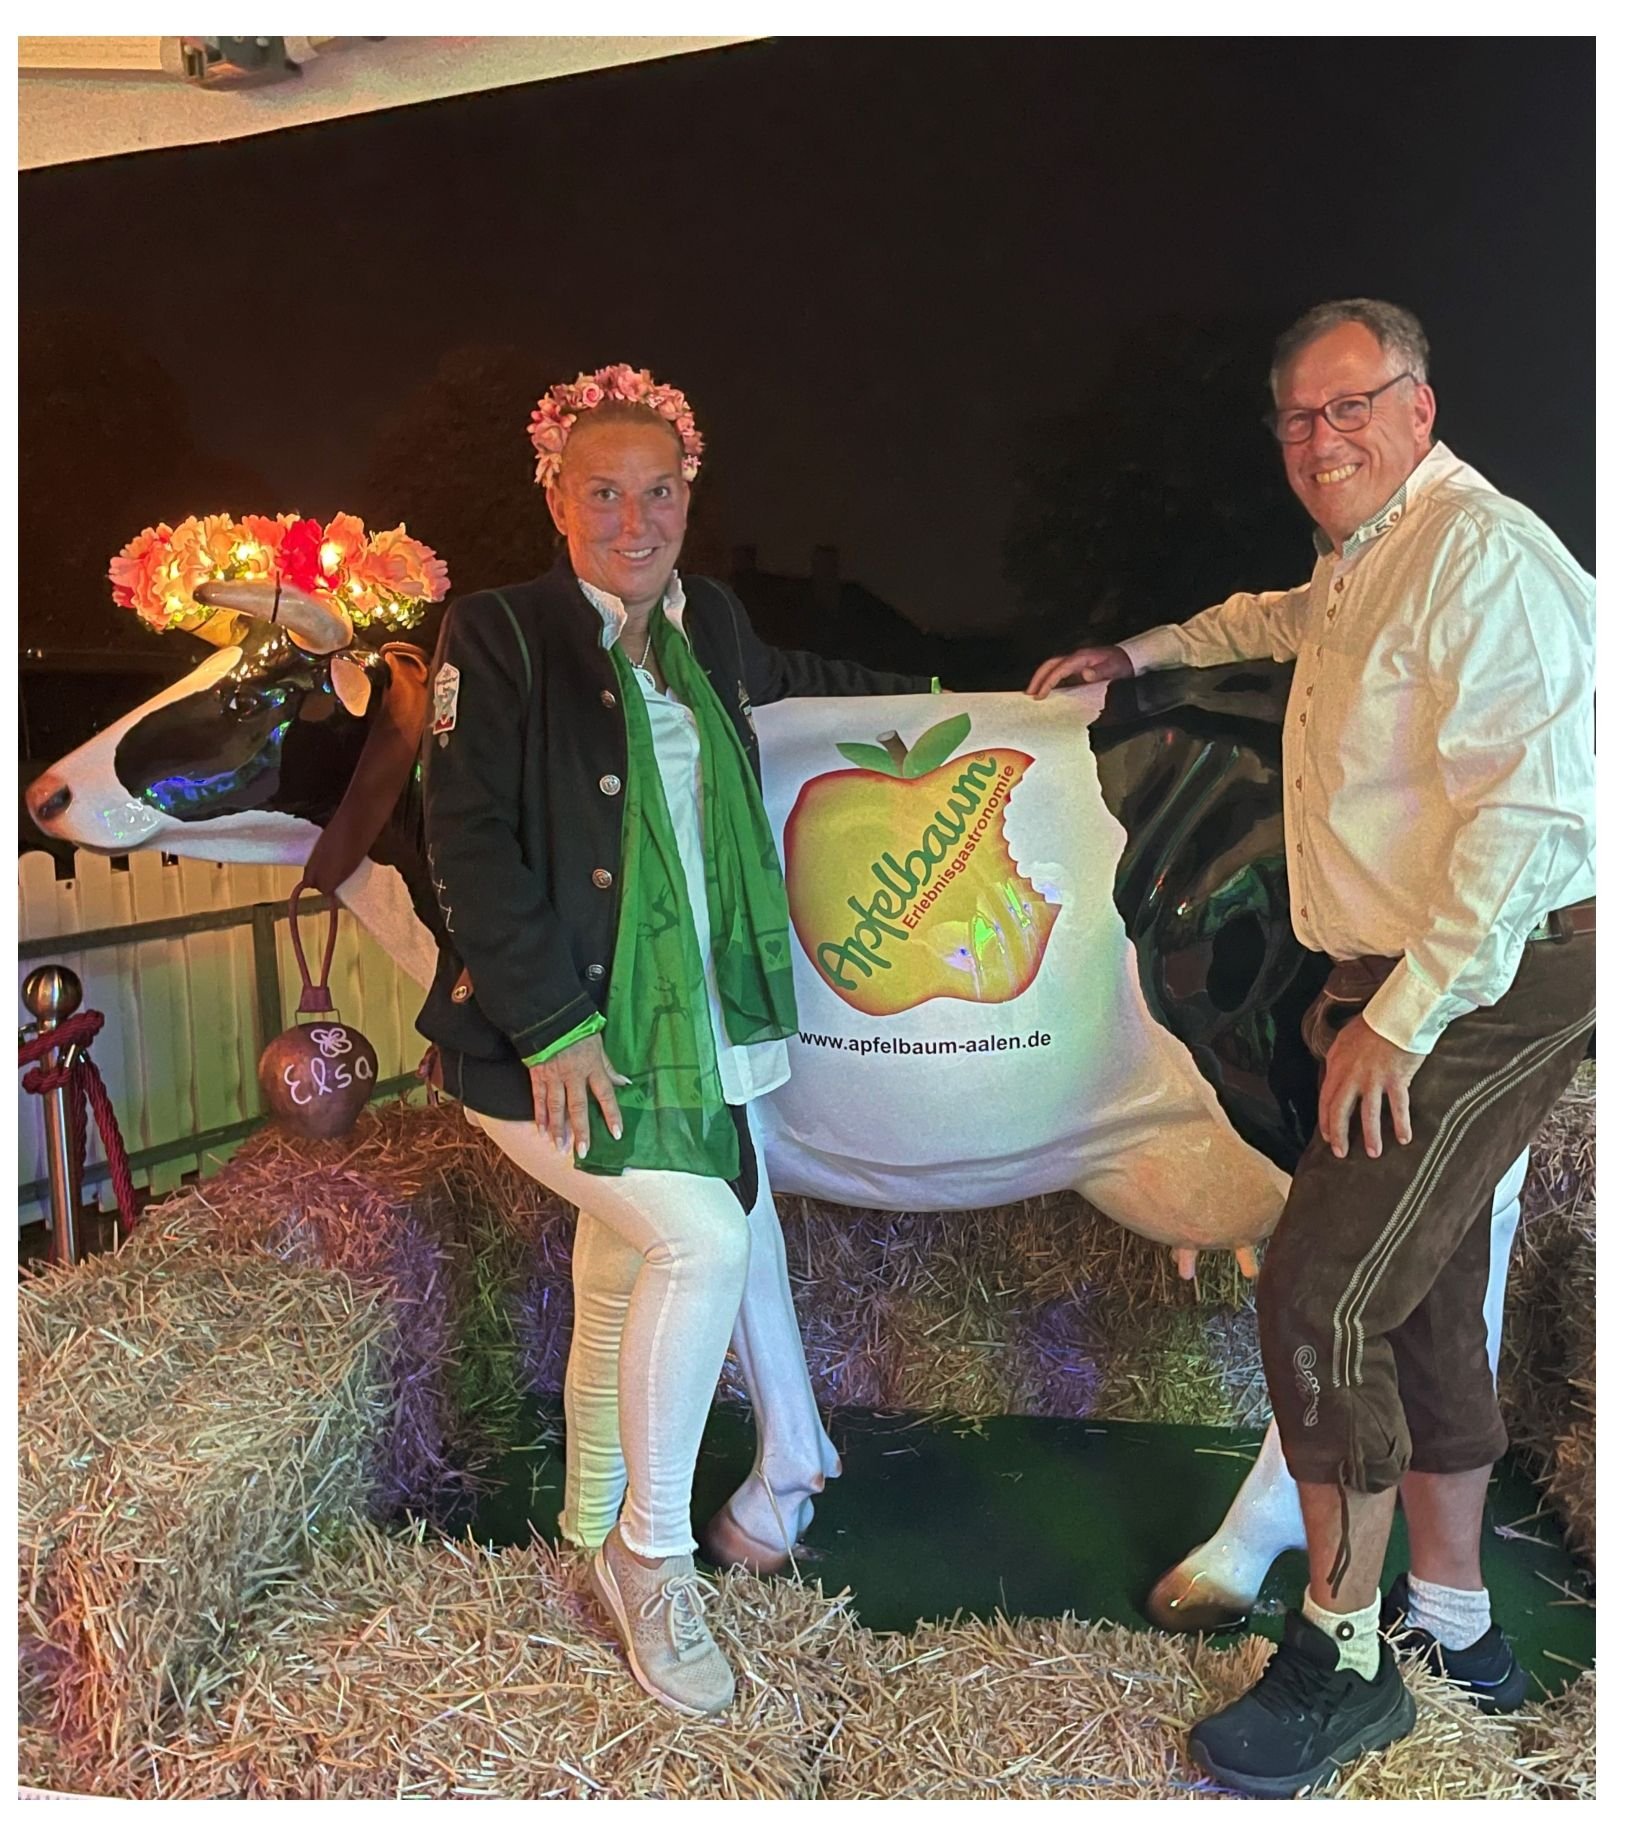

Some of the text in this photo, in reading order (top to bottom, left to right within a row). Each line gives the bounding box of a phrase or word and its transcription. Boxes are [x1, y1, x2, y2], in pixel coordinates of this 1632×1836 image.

[902, 764, 1015, 931] Erlebnisgastronomie
[798, 1030, 1052, 1056] www.apfelbaum-aalen.de
[283, 1056, 374, 1105] Elsa
